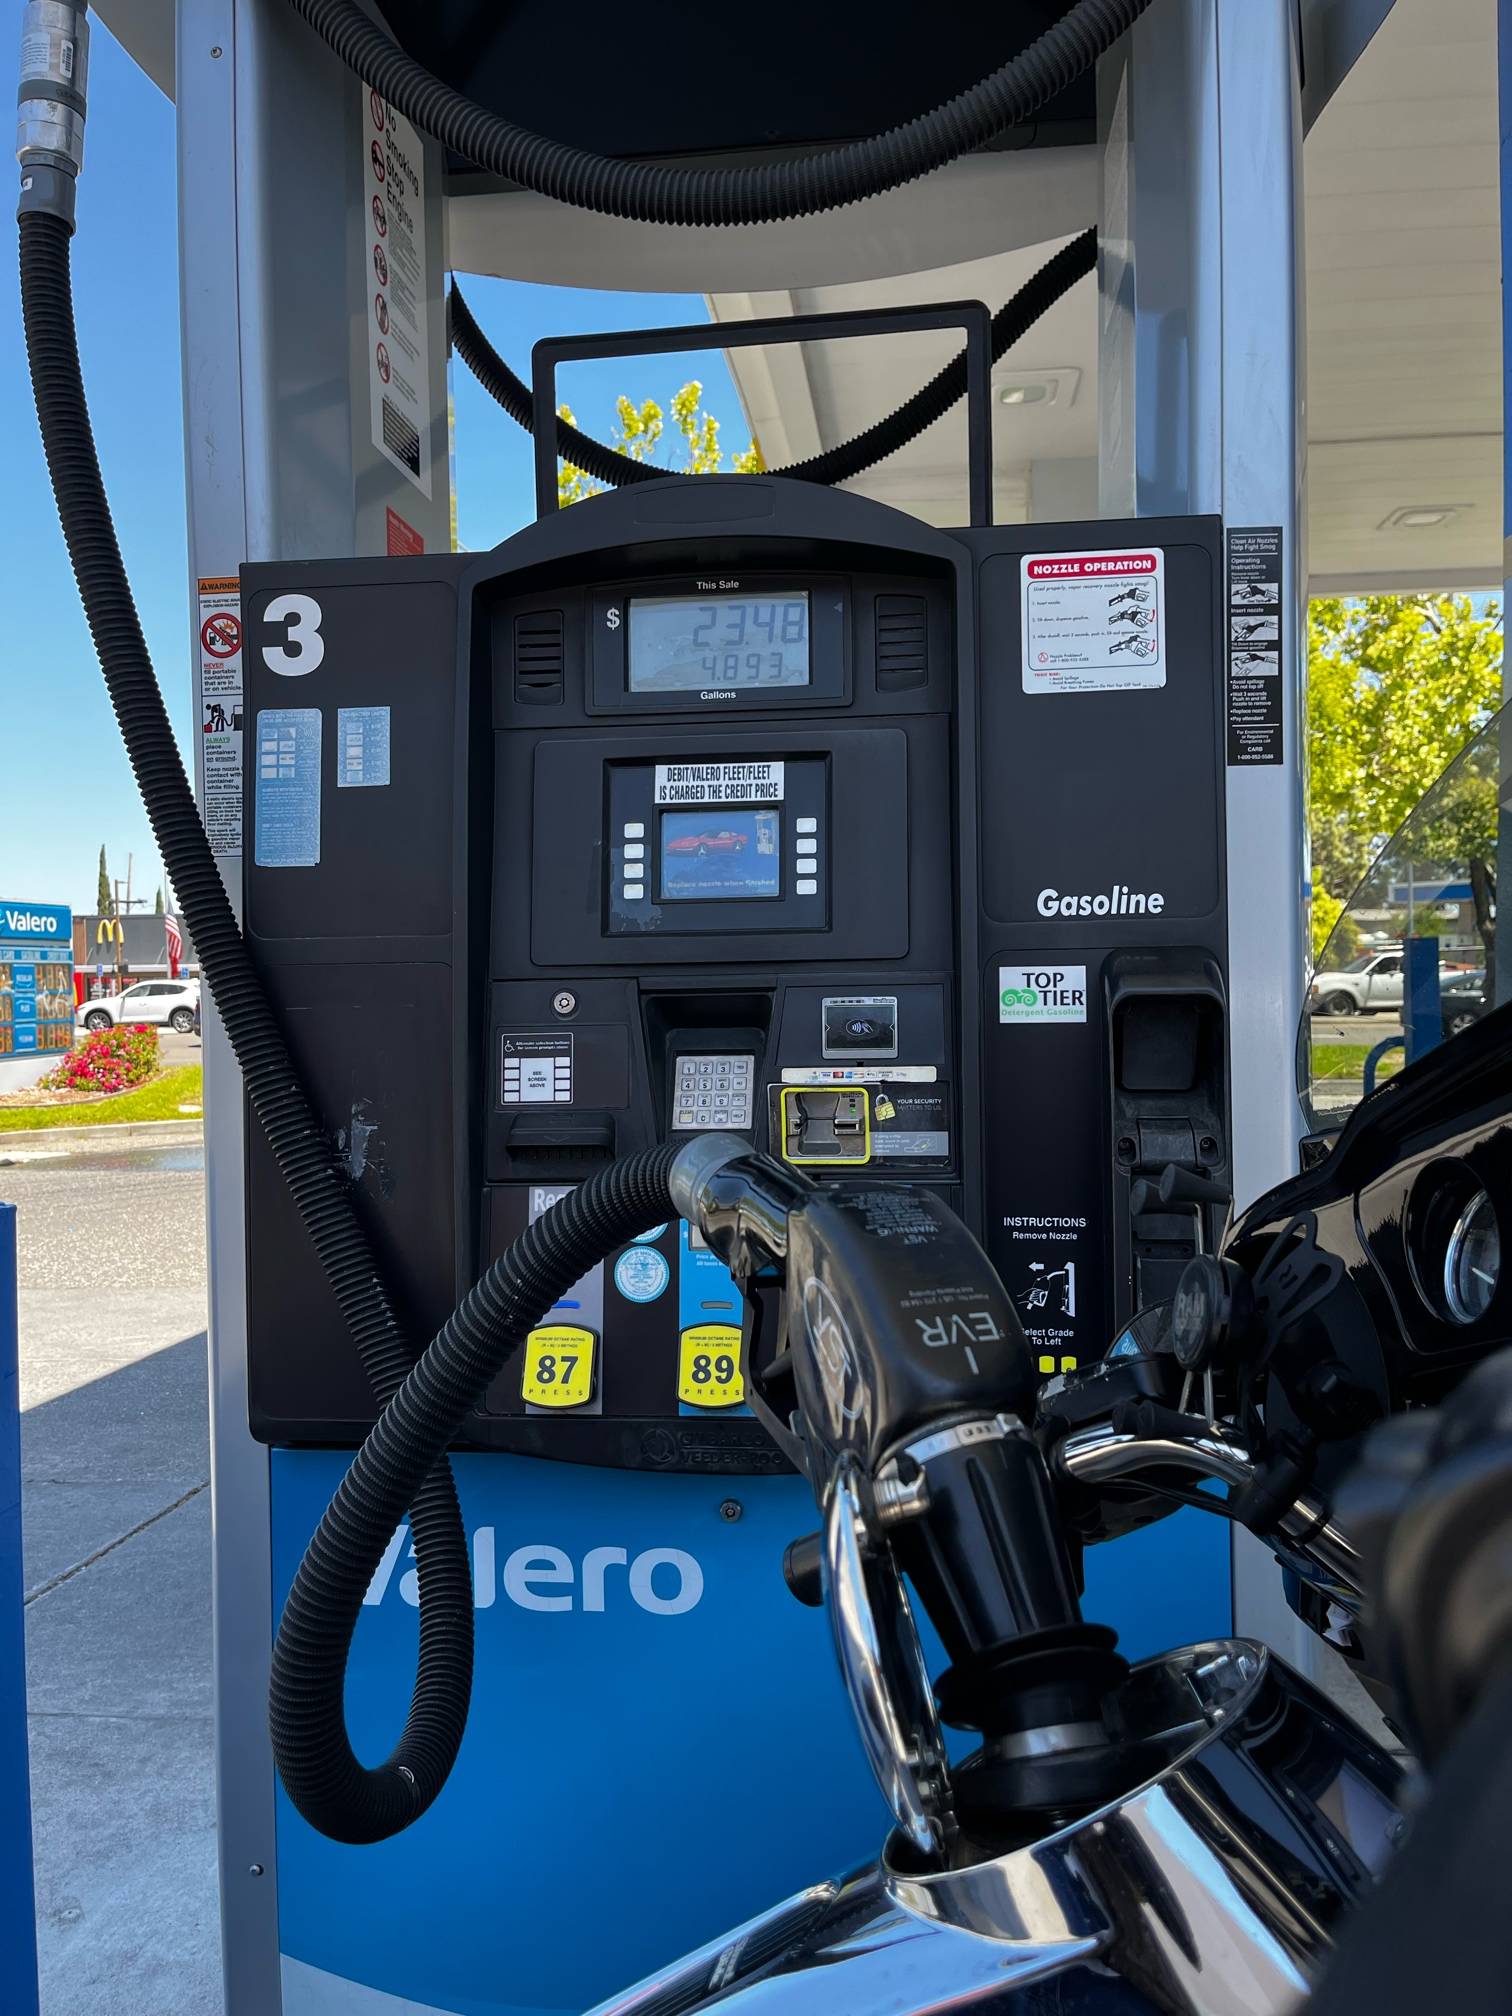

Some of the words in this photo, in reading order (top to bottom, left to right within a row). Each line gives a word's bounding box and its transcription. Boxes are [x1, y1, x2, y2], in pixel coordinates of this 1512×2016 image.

[386, 97, 396, 132] No
[386, 128, 418, 197] Smoking
[386, 154, 404, 198] Stop
[386, 181, 413, 234] Engine
[1034, 564, 1080, 575] NOZZLE
[1084, 560, 1151, 572] OPERATION
[696, 581, 716, 590] This
[719, 580, 740, 589] Sale
[606, 608, 620, 630] $
[692, 602, 806, 647] 23.48
[262, 594, 325, 676] 3
[702, 652, 783, 681] 4.893
[700, 691, 737, 700] Gallons
[667, 766, 720, 783] DEBIT/VALERO
[723, 765, 771, 782] FLEET/FLEET
[660, 785, 667, 800] IS
[669, 784, 705, 800] CHARGED
[708, 784, 723, 799] THE
[724, 783, 753, 799] CREDIT
[755, 782, 778, 798] PRICE
[1036, 885, 1165, 917] Gasoline
[6, 910, 58, 932] Valero
[1022, 972, 1065, 989] TOP
[1038, 990, 1085, 1006] TIER
[1001, 1009, 1044, 1017] Detergent
[1047, 1008, 1084, 1016] Gasoline
[1003, 1216, 1087, 1228] INSTRUCTIONS
[1012, 1231, 1048, 1240] Remove
[1049, 1232, 1078, 1240] Nozzle
[915, 1311, 1000, 1348] EVR
[1048, 1328, 1074, 1337] Grade
[1032, 1336, 1043, 1345] To
[1044, 1336, 1062, 1345] Left
[536, 1355, 579, 1385] 87
[691, 1354, 735, 1384] 89
[680, 1450, 785, 1465] VEEDER-ROO
